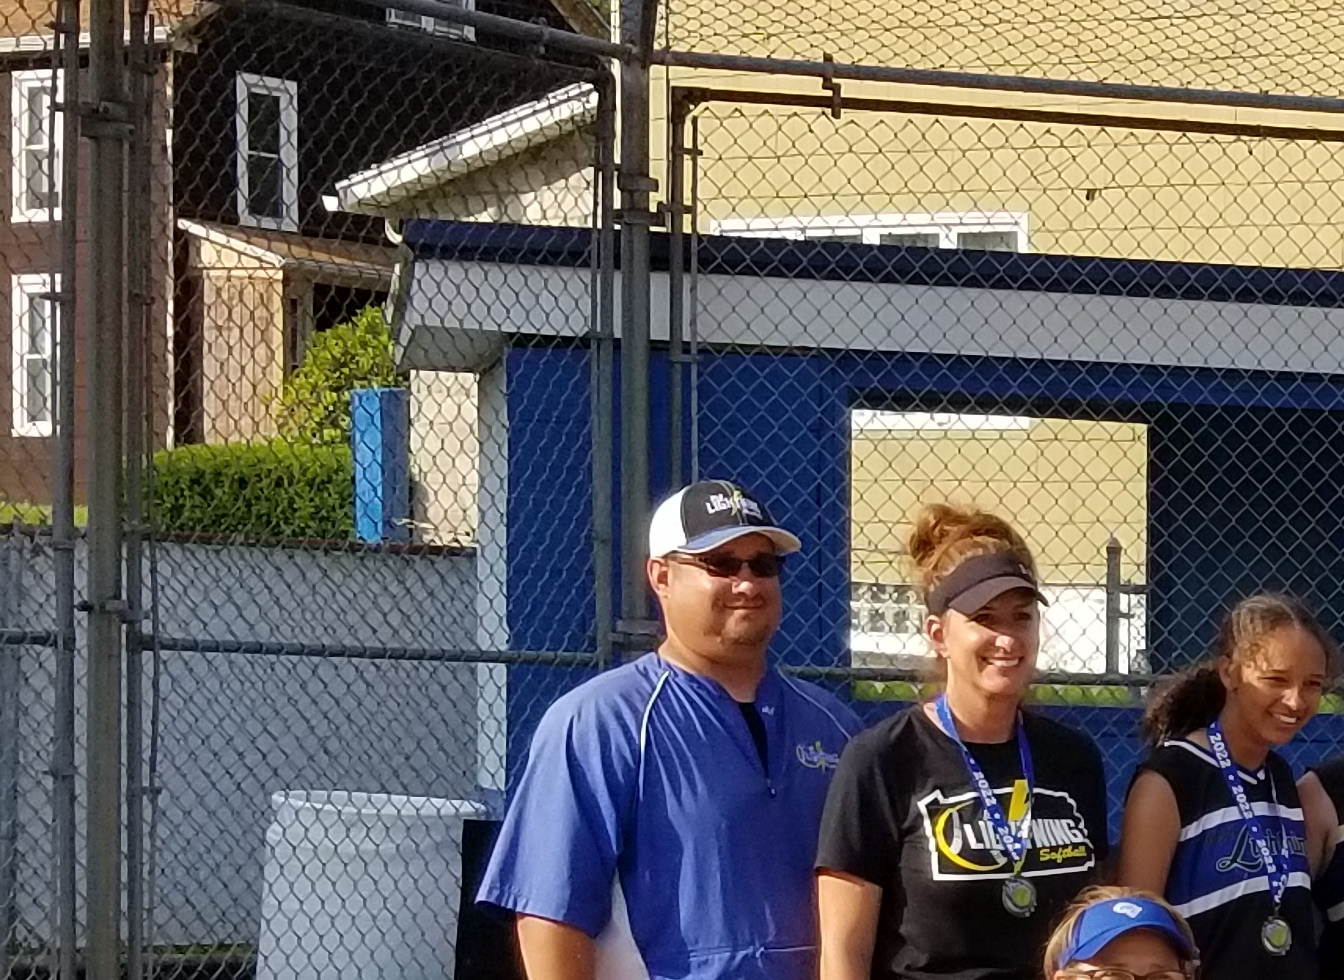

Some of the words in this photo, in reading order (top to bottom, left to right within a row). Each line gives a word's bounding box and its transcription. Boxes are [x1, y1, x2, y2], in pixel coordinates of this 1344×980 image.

[1209, 732, 1231, 769] 2022
[973, 771, 997, 802] 2022
[1231, 785, 1254, 820] 2022
[963, 818, 1084, 850] LIGNING
[1256, 838, 1277, 874] 2022
